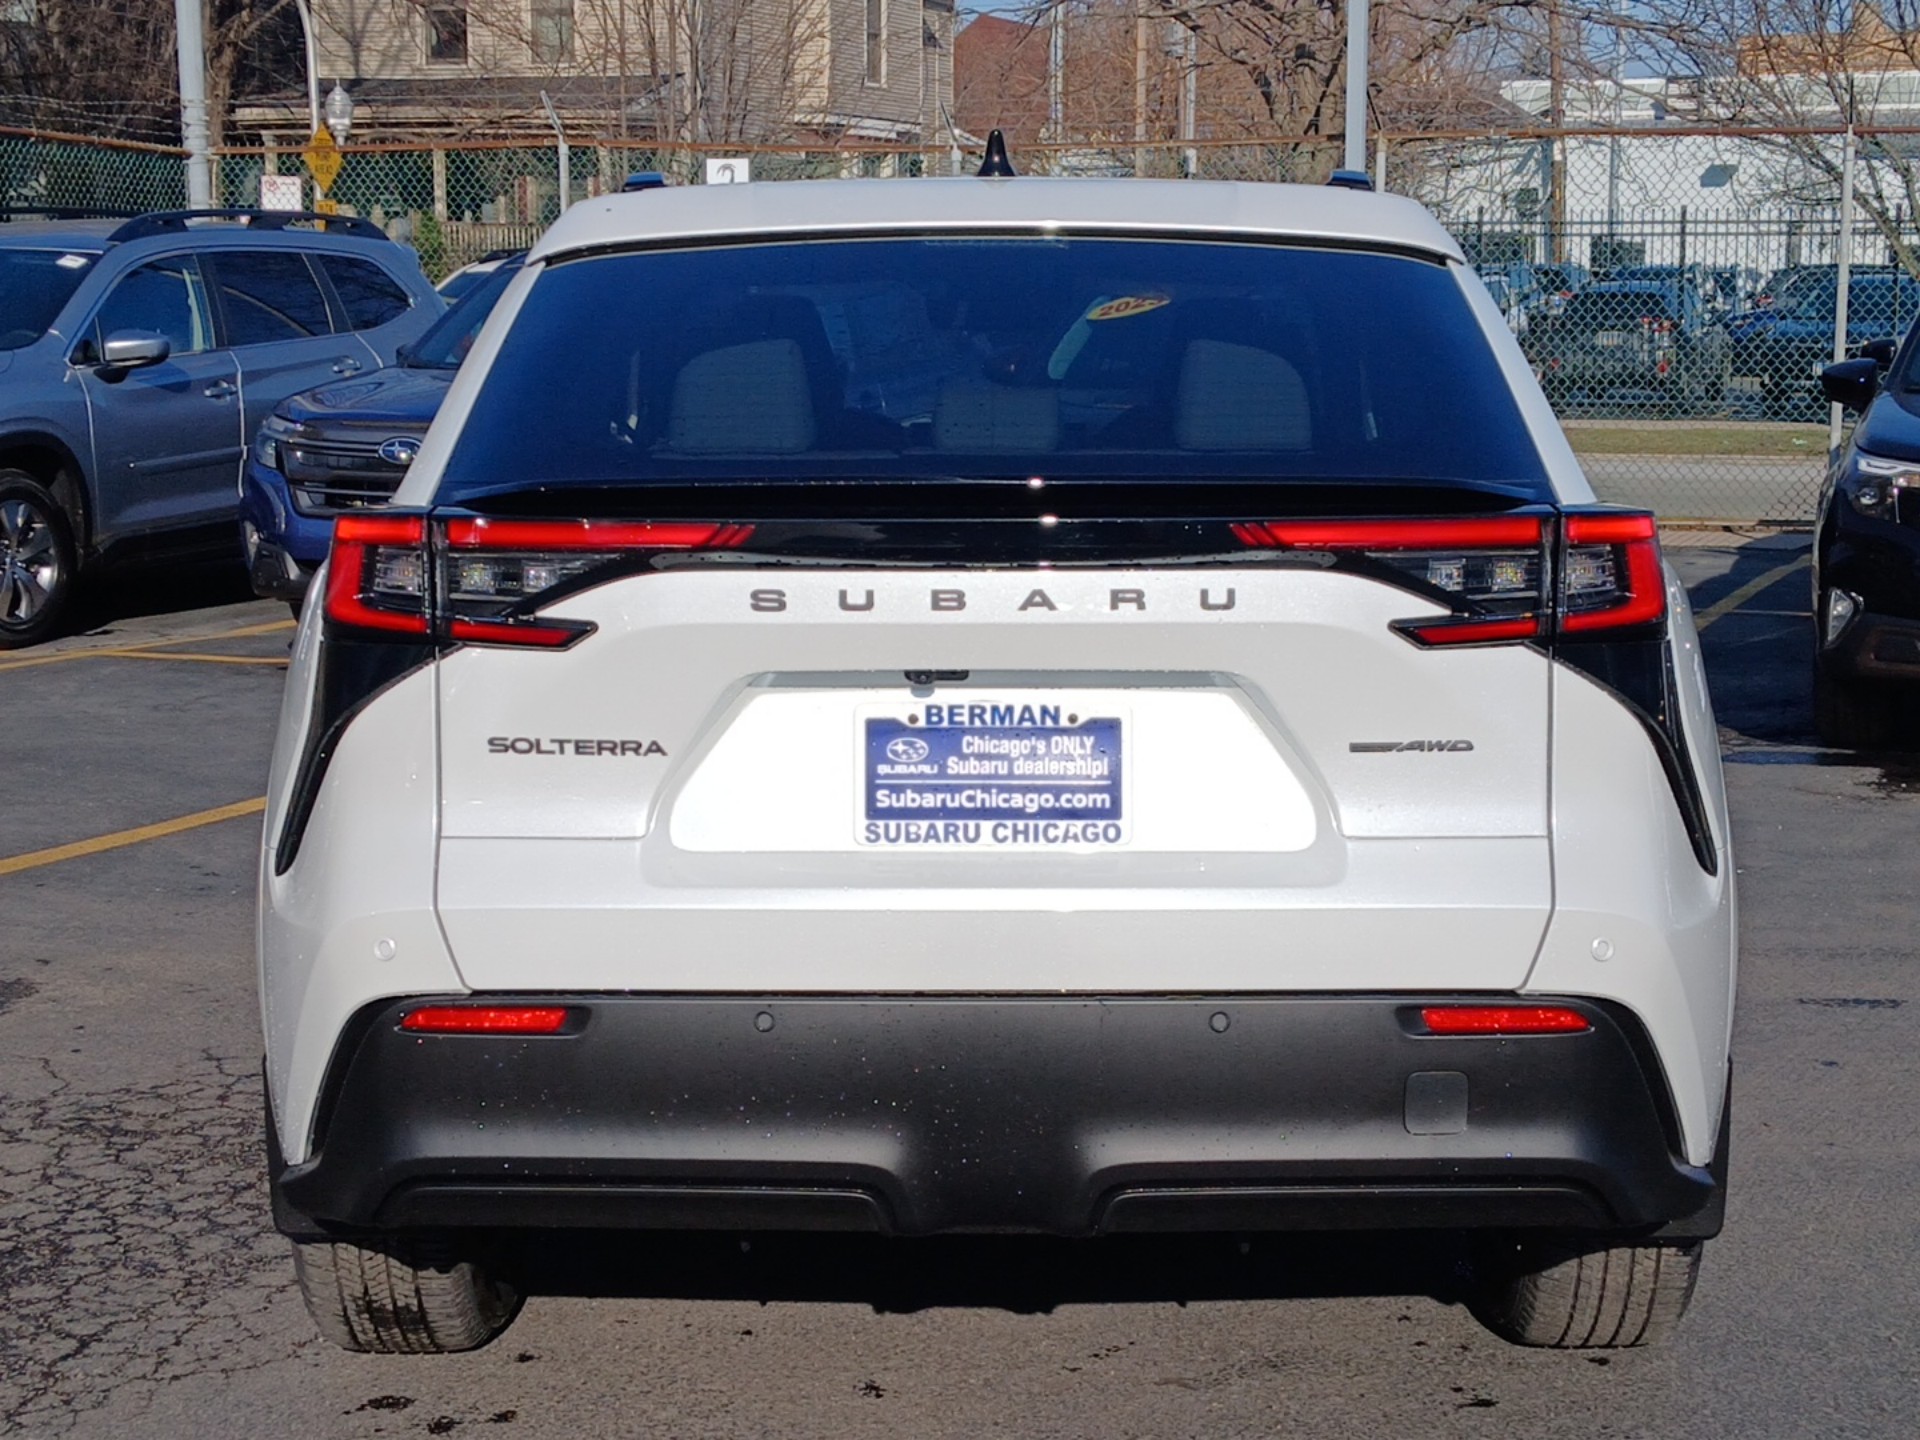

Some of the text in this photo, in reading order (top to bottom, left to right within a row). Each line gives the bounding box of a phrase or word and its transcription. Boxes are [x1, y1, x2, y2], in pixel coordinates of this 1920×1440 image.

[749, 588, 1237, 612] SUBARU
[924, 704, 1061, 726] BERMAN
[487, 736, 668, 757] SOLTERRA
[961, 735, 1095, 757] Chicago's ONLY
[1396, 739, 1475, 752] AWD
[876, 764, 939, 774] SUBARU
[946, 755, 1109, 779] Subaru dealership!
[875, 788, 1111, 813] SubaruChicago.com
[864, 822, 1122, 844] SUBARU CHICAGO
